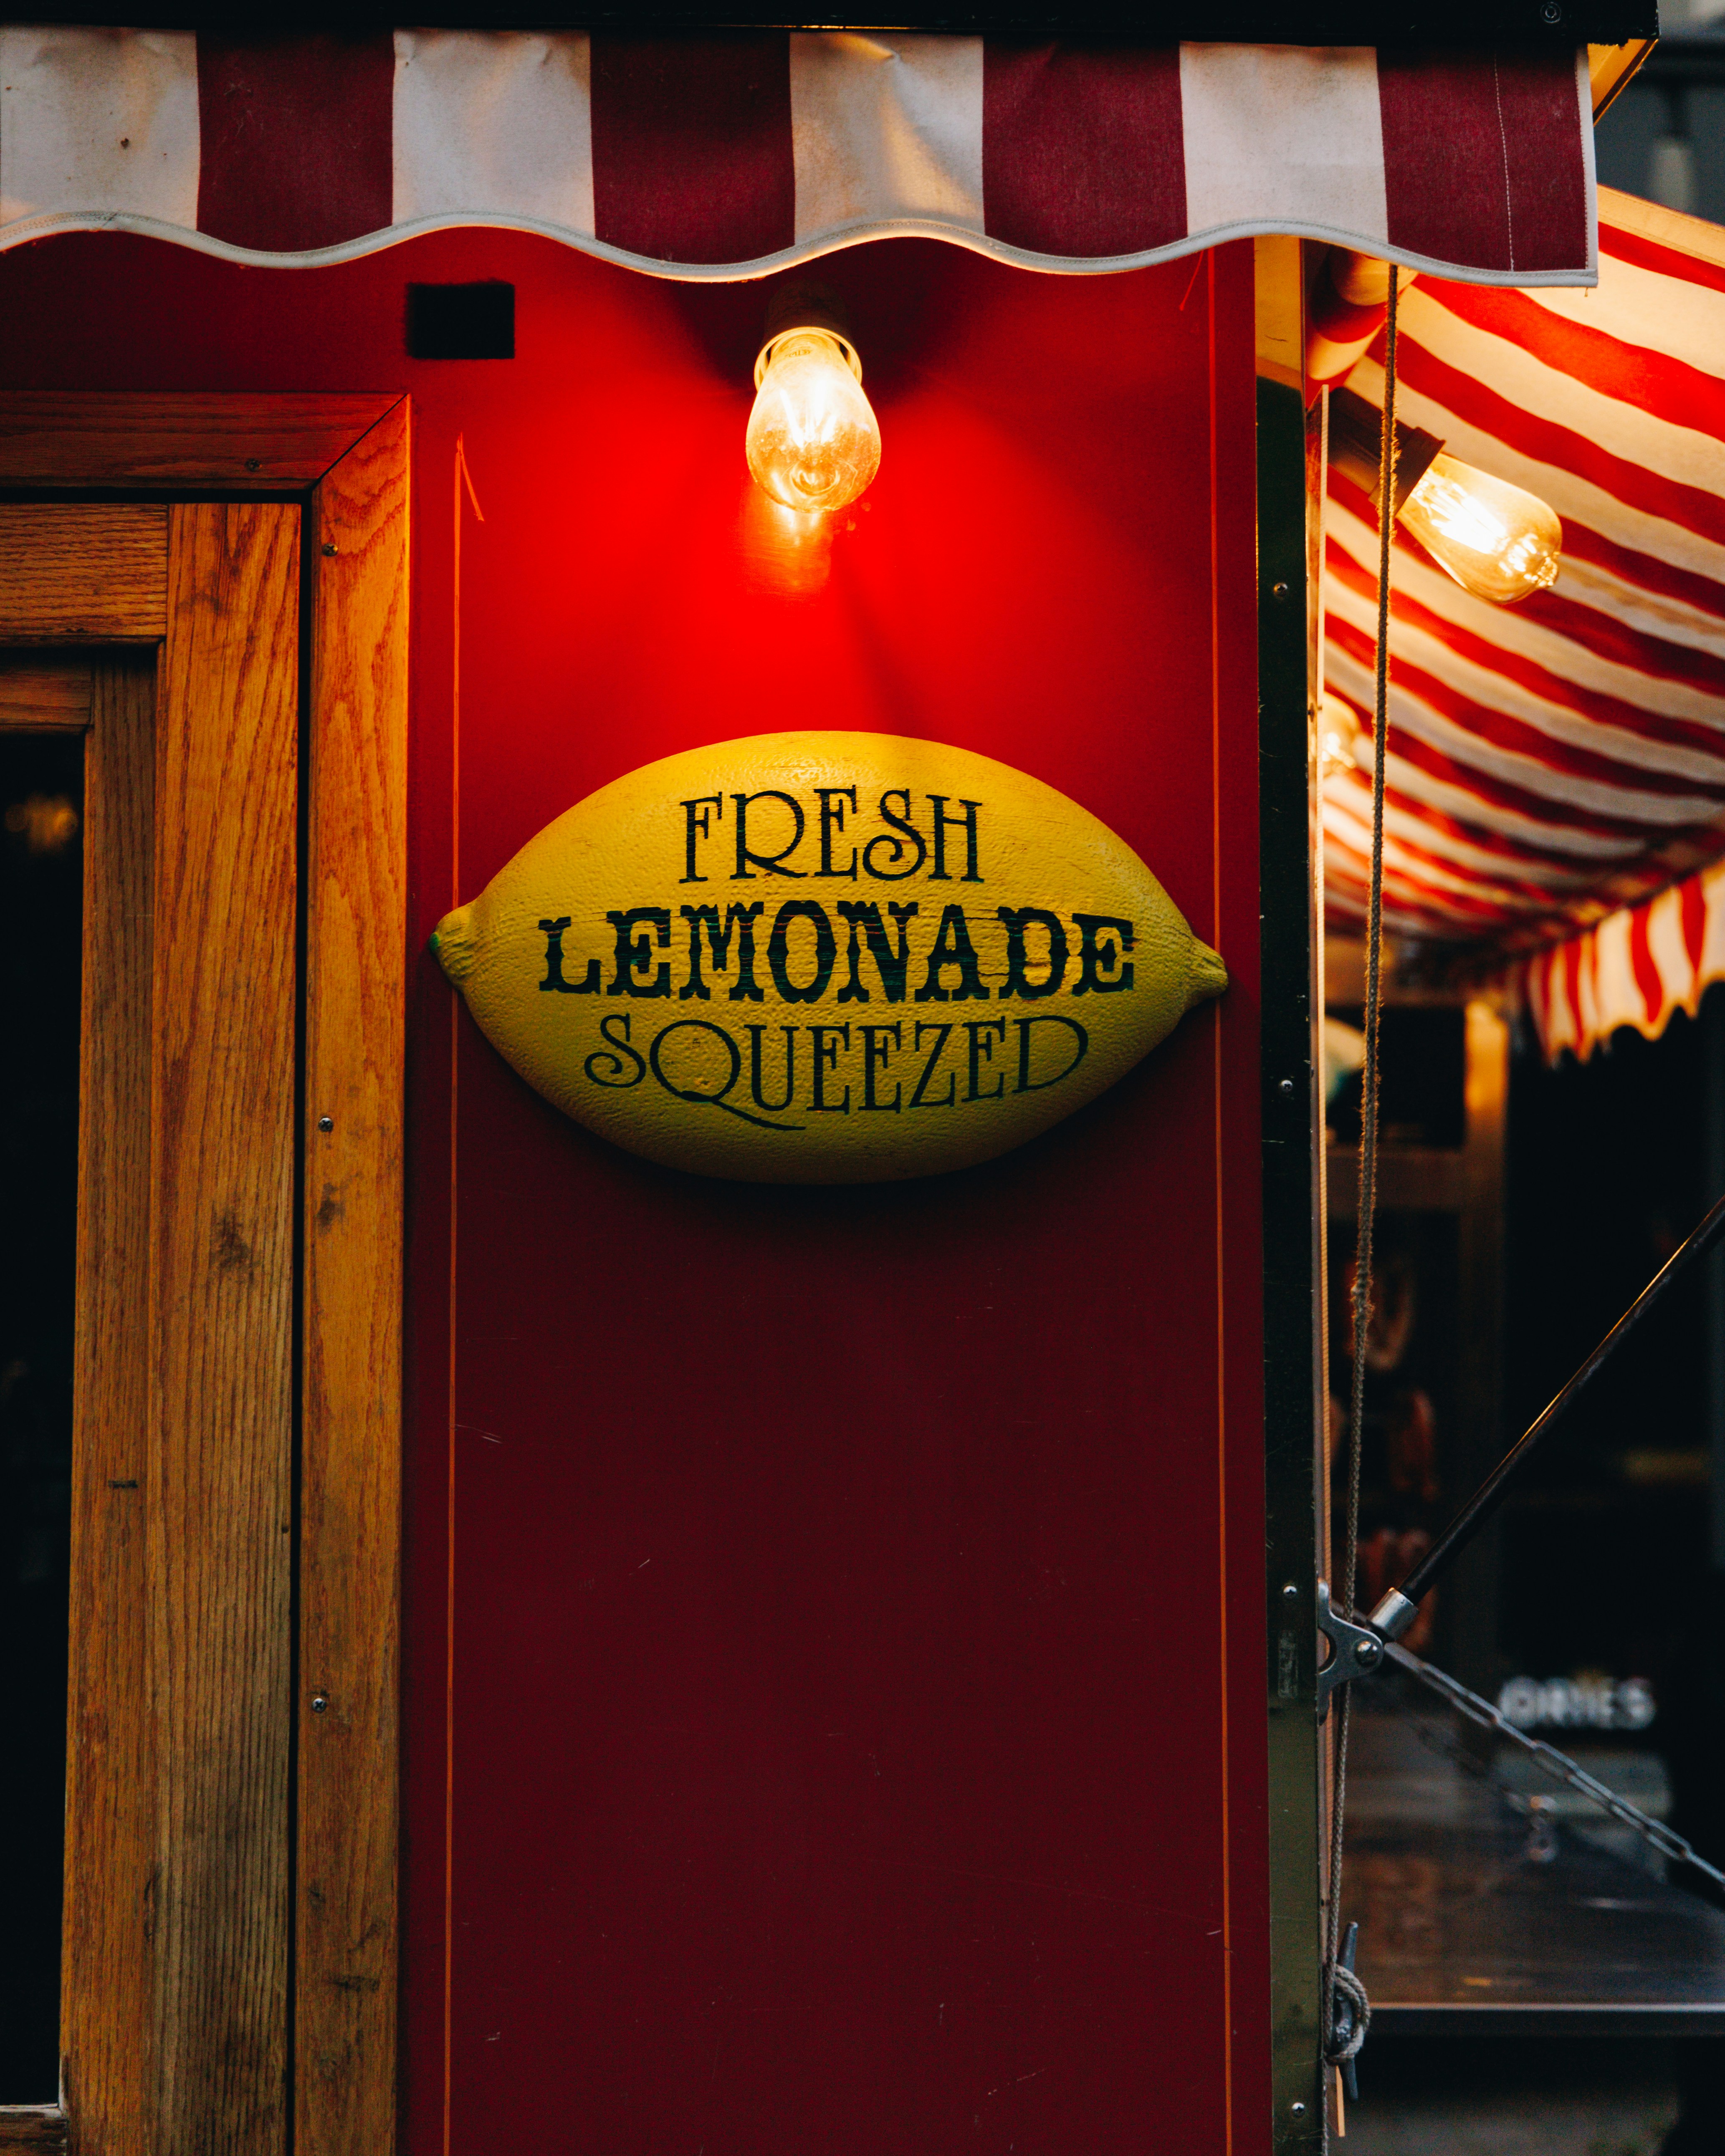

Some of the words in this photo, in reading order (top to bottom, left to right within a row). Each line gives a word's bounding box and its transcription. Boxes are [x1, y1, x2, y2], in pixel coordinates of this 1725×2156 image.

[679, 786, 984, 884] FRESH
[538, 900, 1136, 1003] LEMONADE
[584, 1013, 1089, 1130] SQUEEZED
